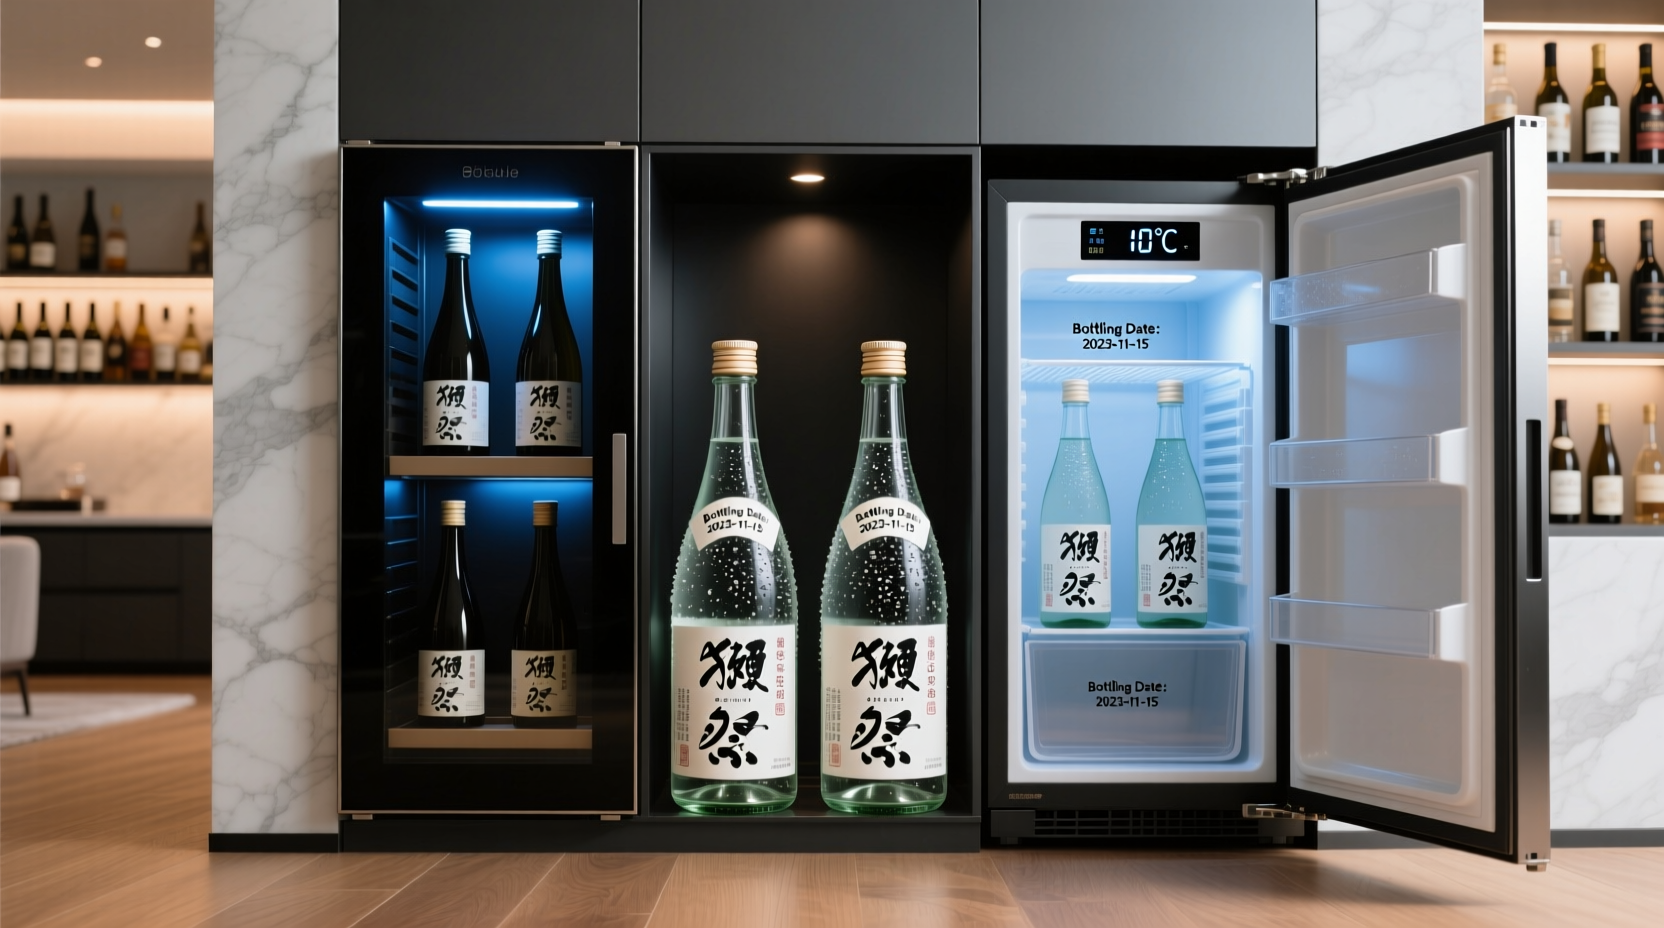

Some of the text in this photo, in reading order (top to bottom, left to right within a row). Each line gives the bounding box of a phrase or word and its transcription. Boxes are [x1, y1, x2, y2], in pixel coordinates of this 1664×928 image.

[1130, 227, 1178, 254] 10°C
[1072, 321, 1160, 338] Bottling Date:
[1082, 338, 1150, 350] 2023-11-15
[1088, 680, 1167, 695] Bottling Date:
[1096, 696, 1159, 707] 2023-11-15
